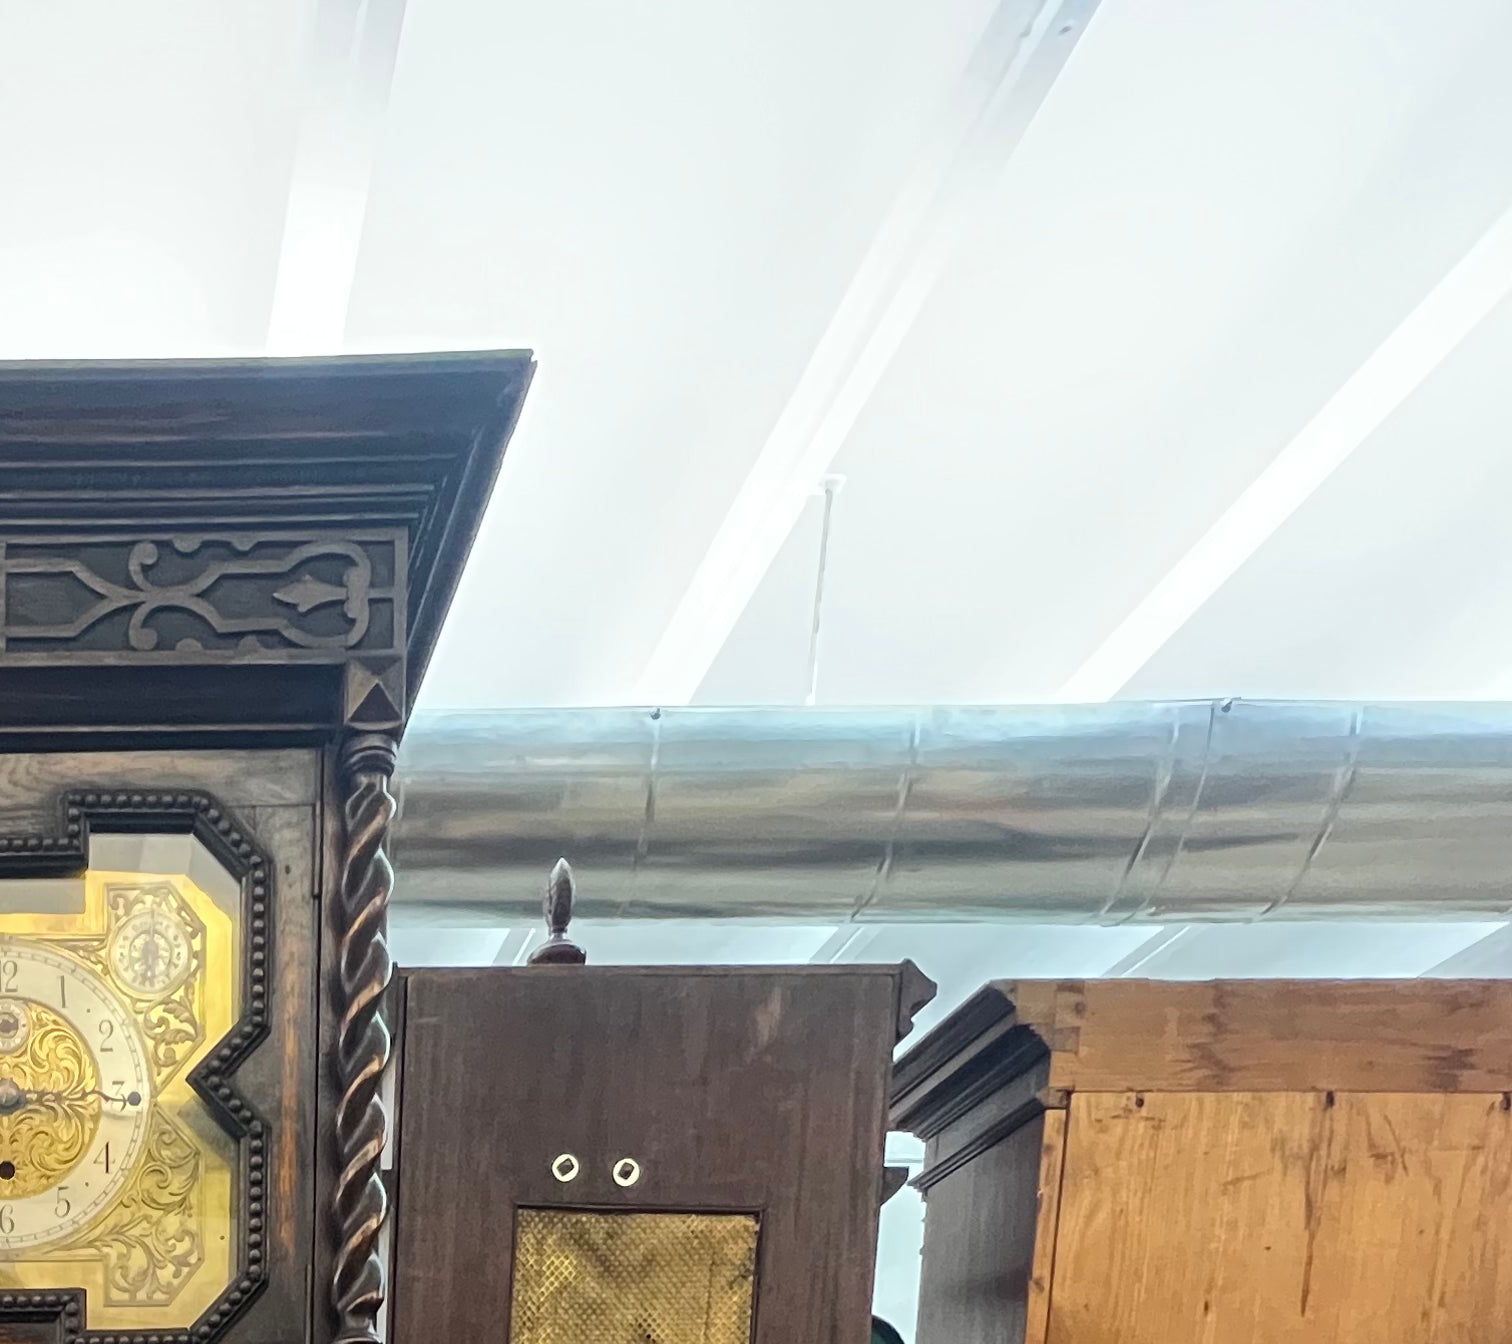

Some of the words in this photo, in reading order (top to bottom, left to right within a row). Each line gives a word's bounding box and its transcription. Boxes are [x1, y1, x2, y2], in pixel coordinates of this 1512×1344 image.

[59, 975, 67, 1008] 1
[98, 1019, 114, 1052] 2
[93, 1141, 112, 1174] 4
[54, 1186, 71, 1219] 5
